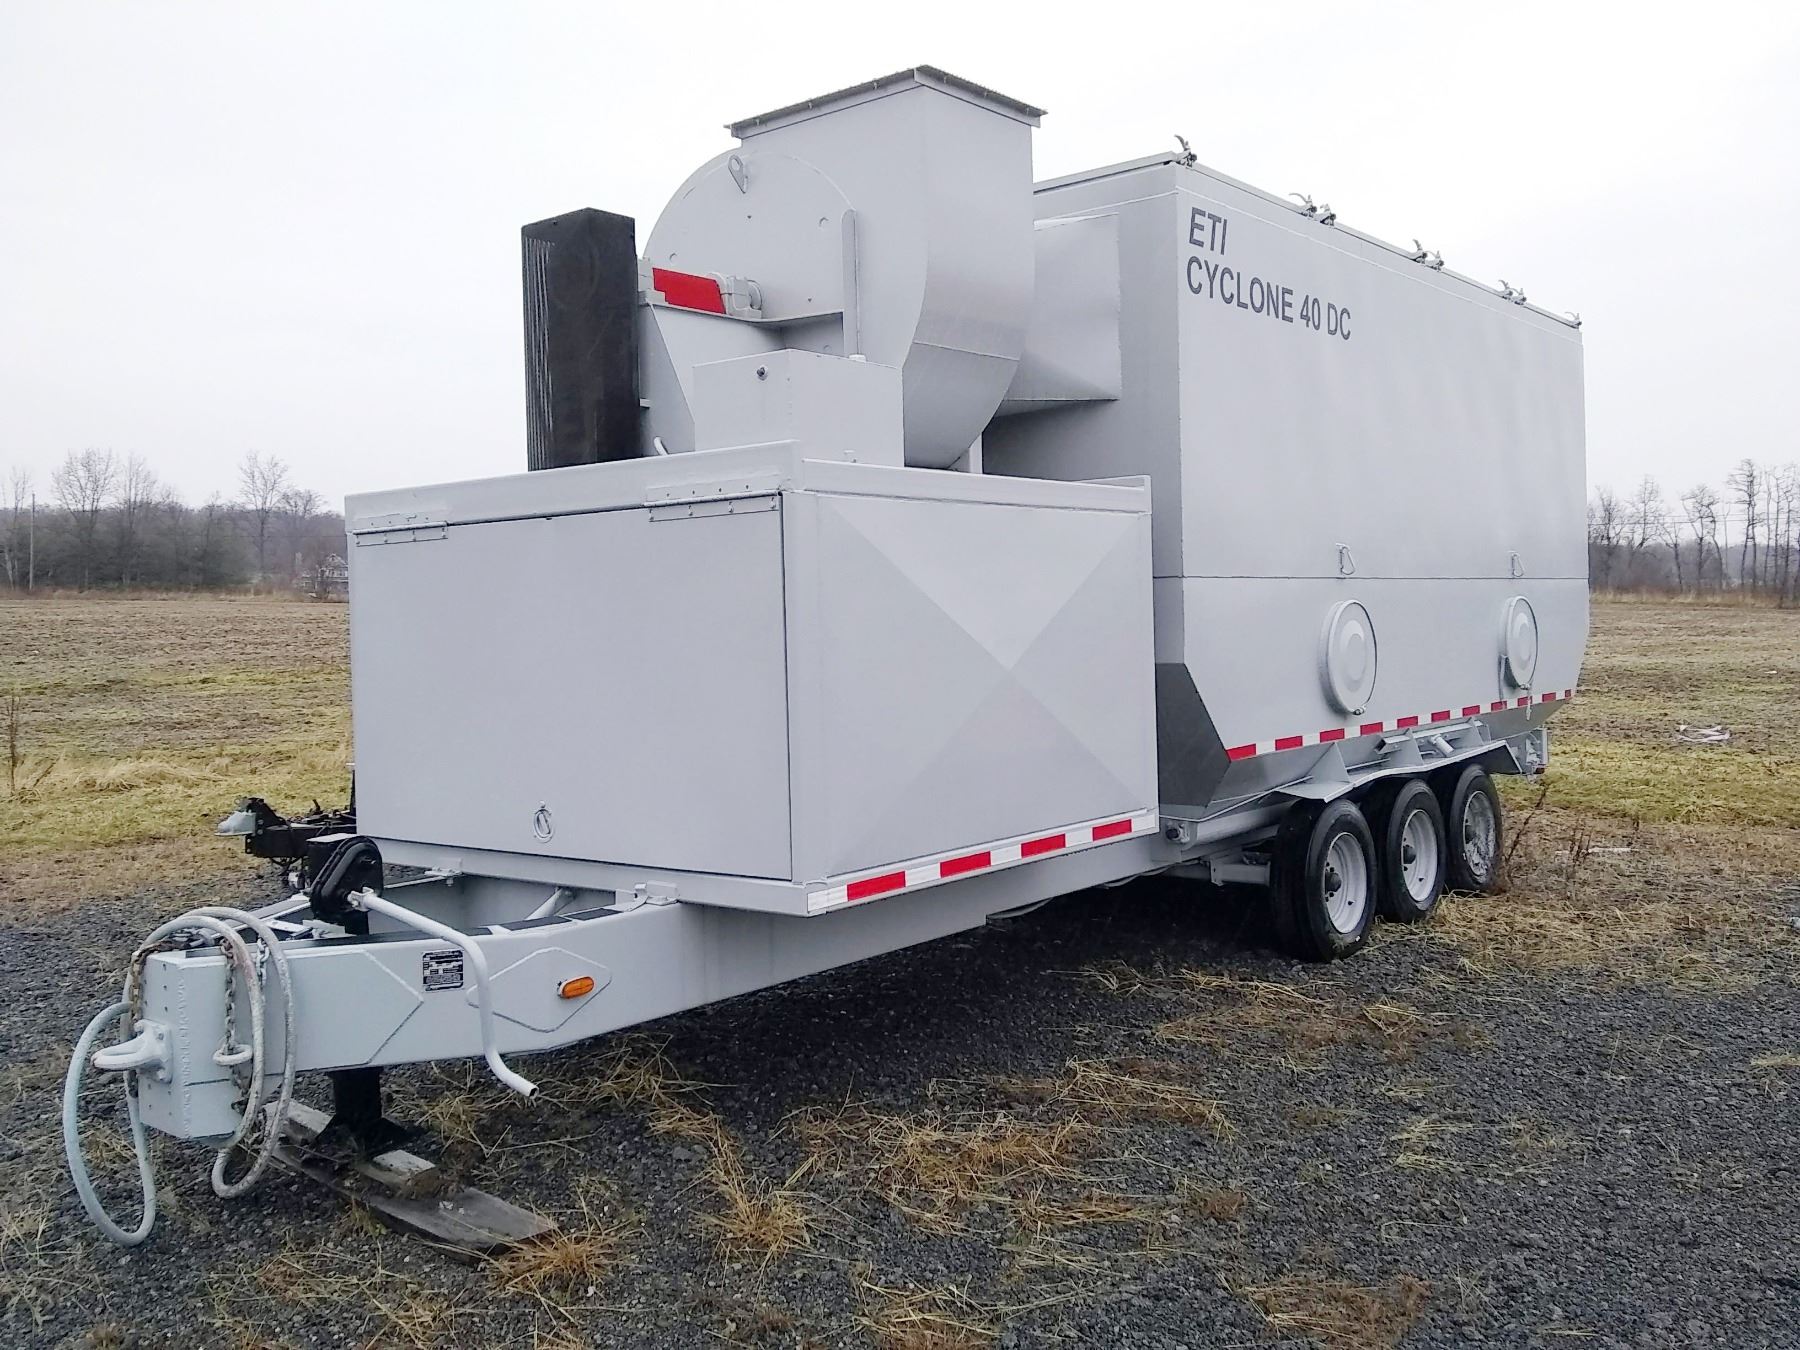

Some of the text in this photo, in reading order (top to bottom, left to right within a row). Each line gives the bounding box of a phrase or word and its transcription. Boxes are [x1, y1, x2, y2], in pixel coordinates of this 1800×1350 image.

[1189, 206, 1227, 255] ETI
[1186, 256, 1351, 340] CYCLONE 40 DC
